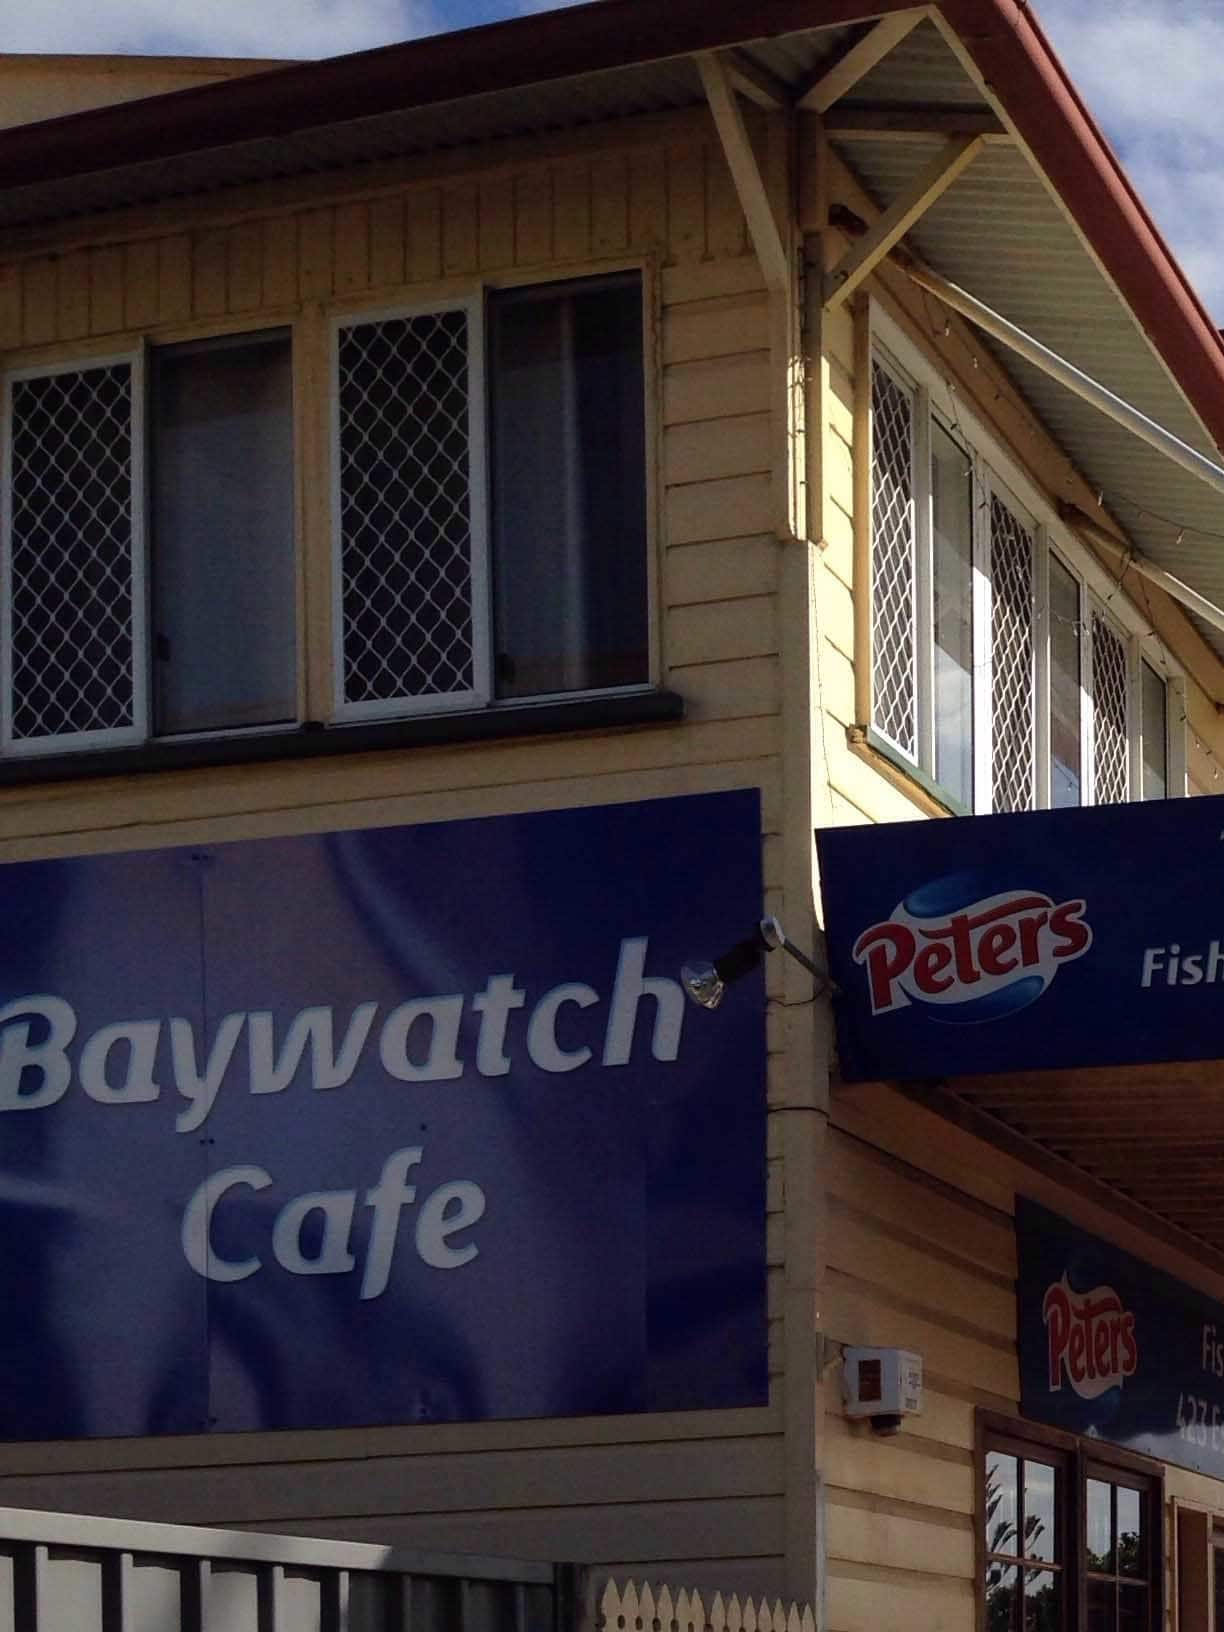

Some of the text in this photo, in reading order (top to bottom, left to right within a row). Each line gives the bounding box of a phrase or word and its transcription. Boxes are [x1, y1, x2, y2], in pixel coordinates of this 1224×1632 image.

[853, 894, 1093, 1016] Peters
[0, 936, 687, 1133] Baywatch
[181, 1146, 488, 1300] Cafe
[1043, 1282, 1137, 1392] Peters
